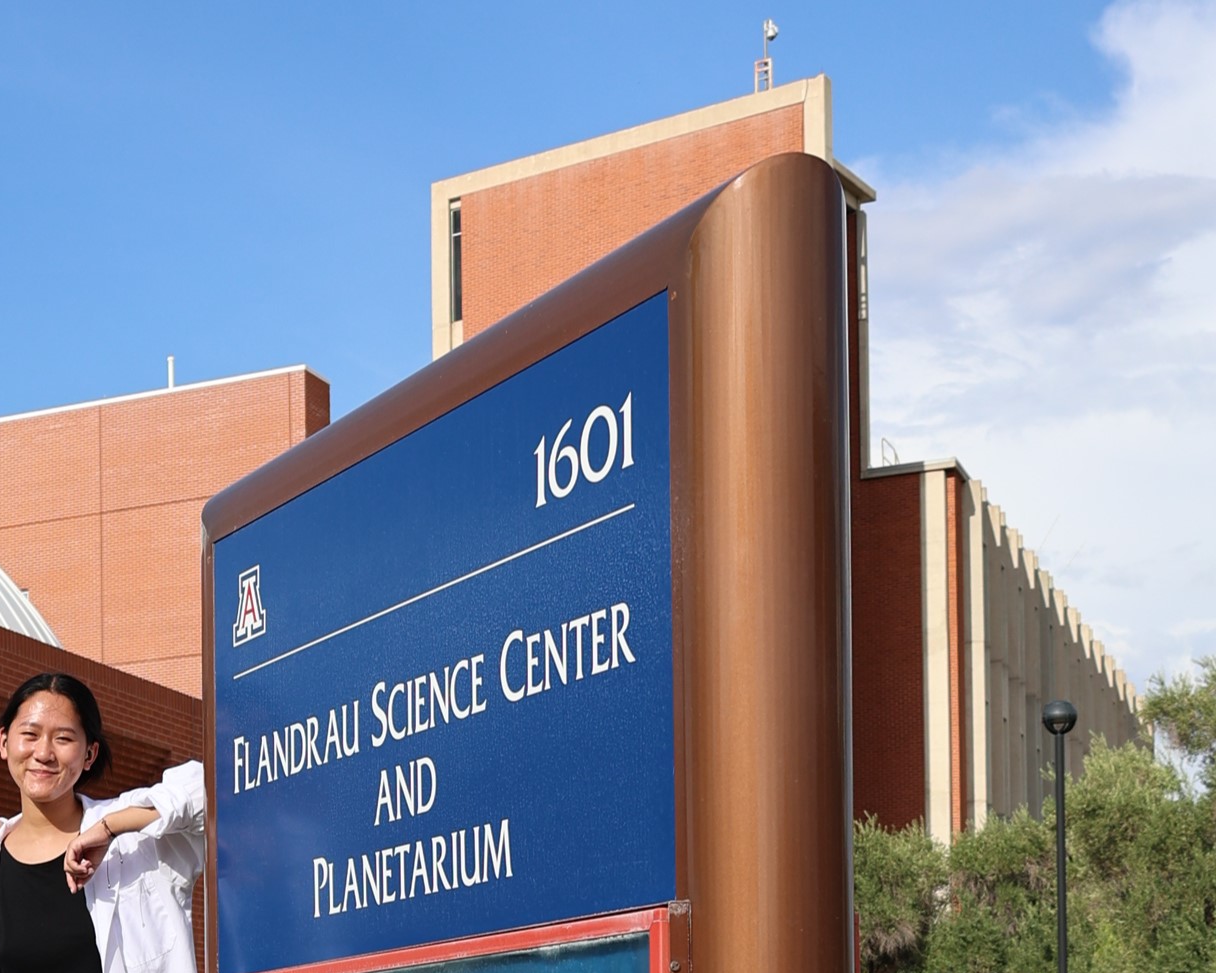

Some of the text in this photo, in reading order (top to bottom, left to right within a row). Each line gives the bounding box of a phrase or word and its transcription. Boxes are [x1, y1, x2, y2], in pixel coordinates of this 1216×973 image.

[533, 390, 635, 509] 1601
[233, 563, 267, 648] A
[233, 601, 637, 795] FLANDRAU SCIENCE CENTER
[374, 756, 438, 827] AND
[313, 818, 514, 918] PLANETARIUM
